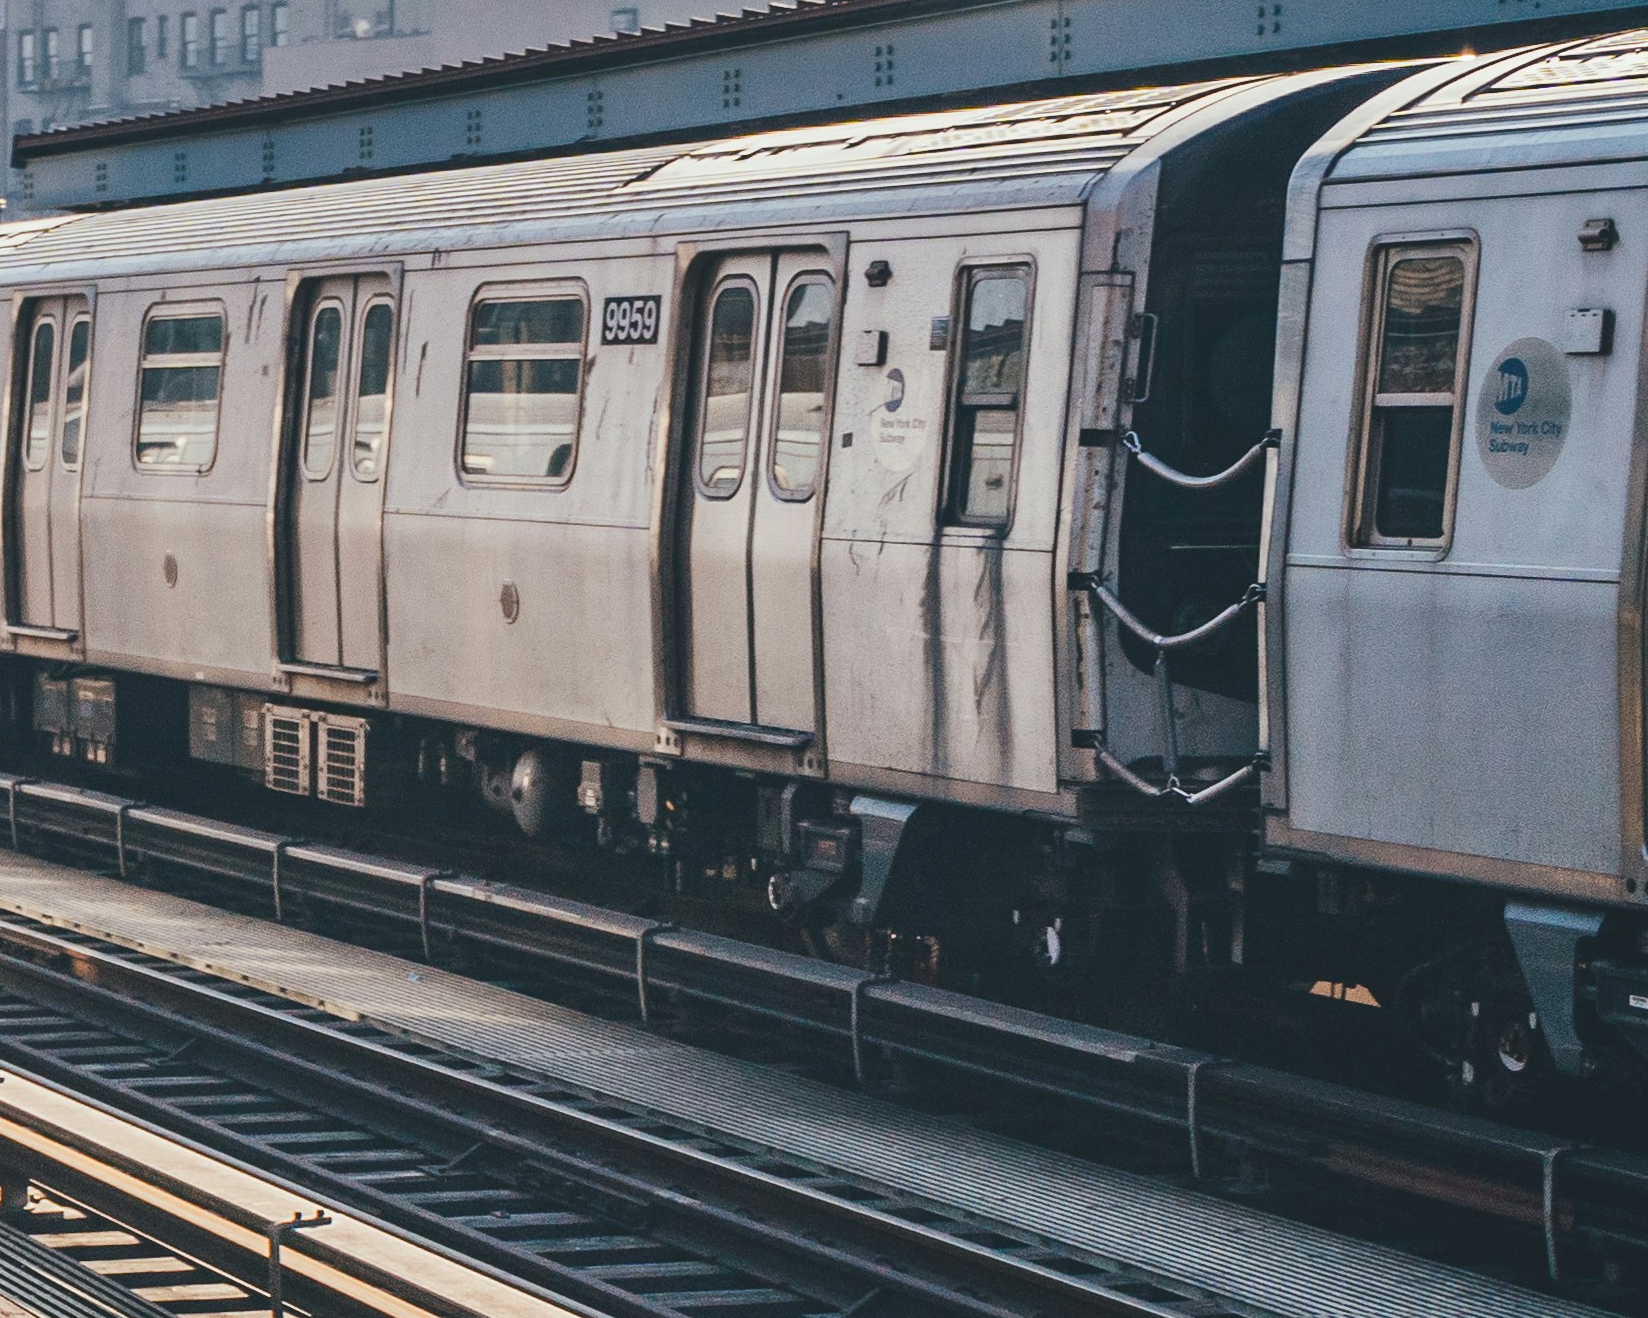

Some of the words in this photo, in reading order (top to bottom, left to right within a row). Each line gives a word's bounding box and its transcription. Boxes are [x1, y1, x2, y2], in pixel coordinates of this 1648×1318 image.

[604, 300, 657, 341] 9959
[1490, 421, 1514, 435] New
[1516, 421, 1539, 435] York
[1541, 421, 1564, 438] City
[1488, 438, 1530, 456] Subway
